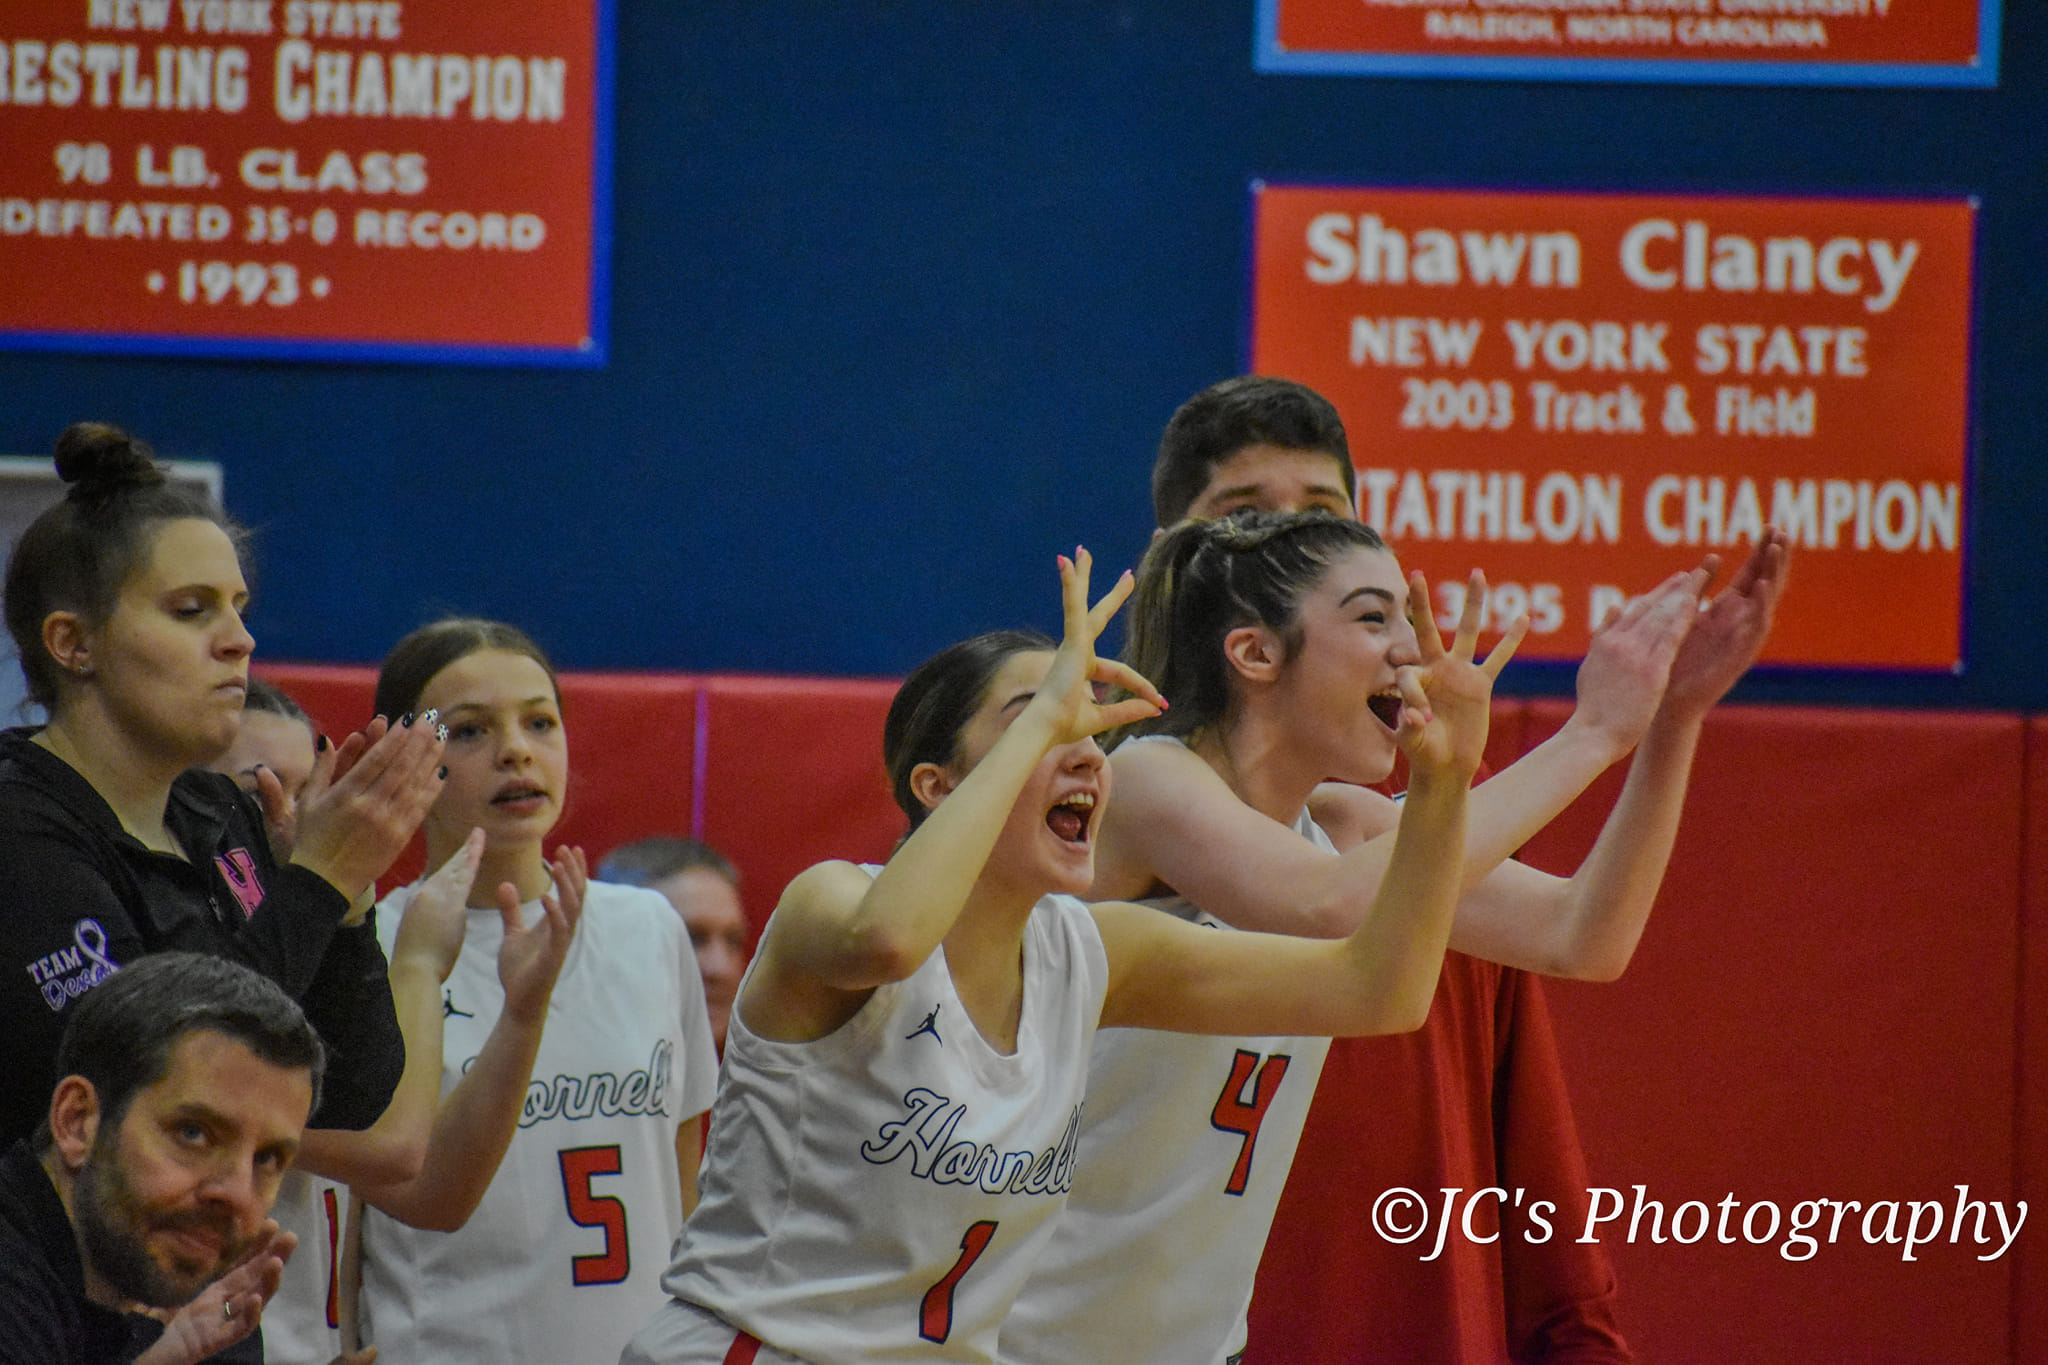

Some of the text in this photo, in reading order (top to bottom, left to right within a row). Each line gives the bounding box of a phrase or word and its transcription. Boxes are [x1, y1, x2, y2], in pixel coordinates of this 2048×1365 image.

[89, 0, 400, 39] NEW YORK STATE
[1568, 15, 1672, 44] NORTH
[1675, 17, 1828, 47] CAROLINA
[55, 143, 428, 195] 98 LB. CLASS
[0, 199, 231, 241] DEFEATED
[354, 210, 546, 251] RECORD
[1305, 213, 1919, 313] Shawn Clancy
[1350, 316, 1869, 378] NEW YORK STATE
[1401, 379, 1817, 438] 2003 Track & Field
[1356, 468, 1962, 552] TATHLON CHAMPION
[26, 945, 83, 985] TEAM
[462, 1039, 675, 1129] ornell
[861, 1087, 1084, 1195] Hornell
[1210, 1048, 1291, 1197] 4
[557, 1143, 631, 1288] 5
[919, 1219, 999, 1344] 1
